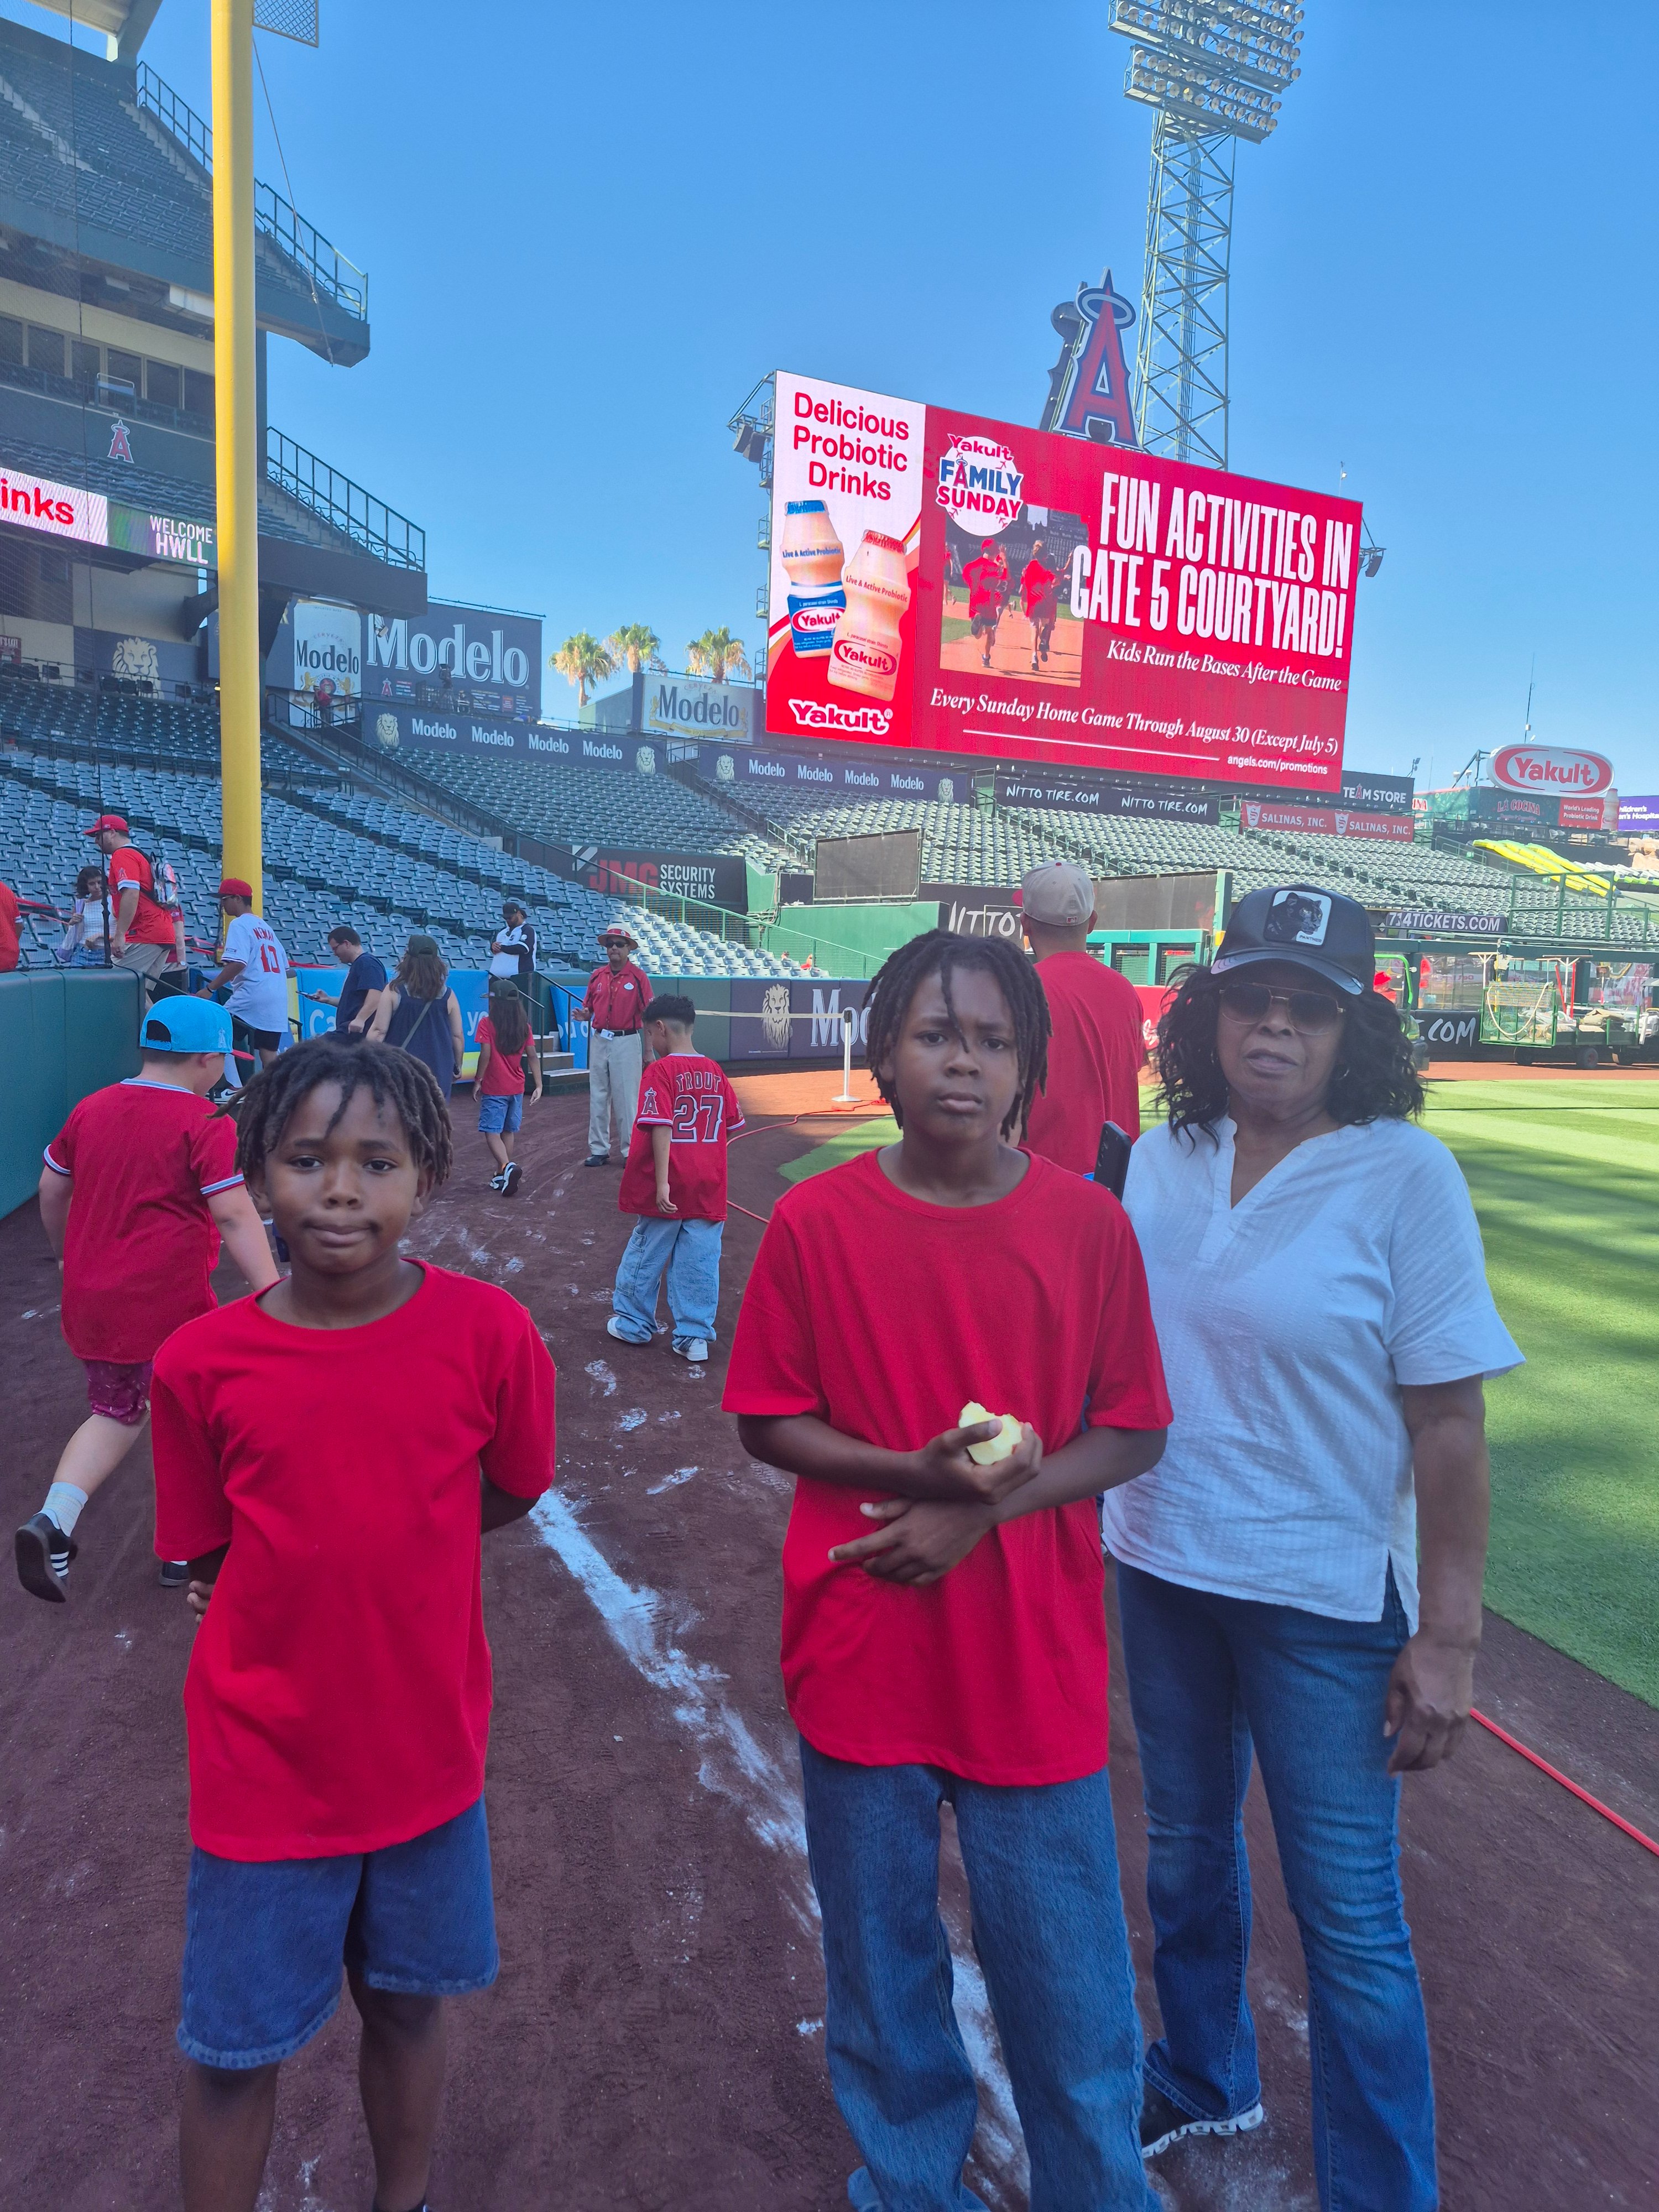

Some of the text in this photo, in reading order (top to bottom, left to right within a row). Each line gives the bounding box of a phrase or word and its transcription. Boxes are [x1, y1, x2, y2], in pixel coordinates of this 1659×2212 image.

[795, 392, 909, 440] Delicious
[794, 425, 907, 472] Probiotic
[948, 434, 1014, 461] Yakult
[809, 461, 891, 500] Drinks
[941, 456, 1022, 496] FAMILY
[938, 485, 1021, 519] SUNDAY
[150, 515, 213, 544] WELCOME
[1100, 472, 1353, 589] FUN ACTIVITIES IN
[155, 533, 208, 565] HWLL
[800, 549, 816, 557] Active
[817, 547, 841, 555] Probiotic
[846, 575, 858, 585] Live
[863, 581, 881, 594] Active
[881, 587, 908, 603] Probiotic
[1070, 545, 1347, 659] GATE 5 COURTYARD!
[801, 612, 841, 627] Yakult
[296, 639, 359, 675] Modelo
[842, 645, 889, 671] Yakult
[1106, 640, 1342, 691] Kids Run the Bases After the Game
[659, 684, 739, 728] Modelo
[930, 687, 1338, 757] Every Sunday Home Game Through August 30 (Except July 5)
[412, 718, 623, 760] Modelo Modelo Modelo Modelo
[749, 759, 925, 791] Modelo Modelo Modelo Modelo
[1227, 755, 1328, 775] angels.com/promotions
[1514, 757, 1595, 786] Yakult
[1006, 783, 1099, 806] NITTO TIRE.COM
[1121, 795, 1208, 817] NITTO TIRE.COM
[1343, 783, 1407, 804] TEAM STORE
[1497, 798, 1540, 816] LA COCINA
[1261, 812, 1327, 828] SALINAS, INC.
[1563, 812, 1584, 820] Probiotic
[1581, 806, 1599, 815] Leading
[1349, 821, 1411, 836] SALINAS, INC.
[660, 864, 716, 883] SECURITY
[660, 881, 716, 900] SYSTEMS
[1389, 912, 1501, 932] 714TICKETS.COM
[260, 943, 281, 974] 10
[675, 1071, 722, 1093] TROUT
[670, 1094, 724, 1144] 27
